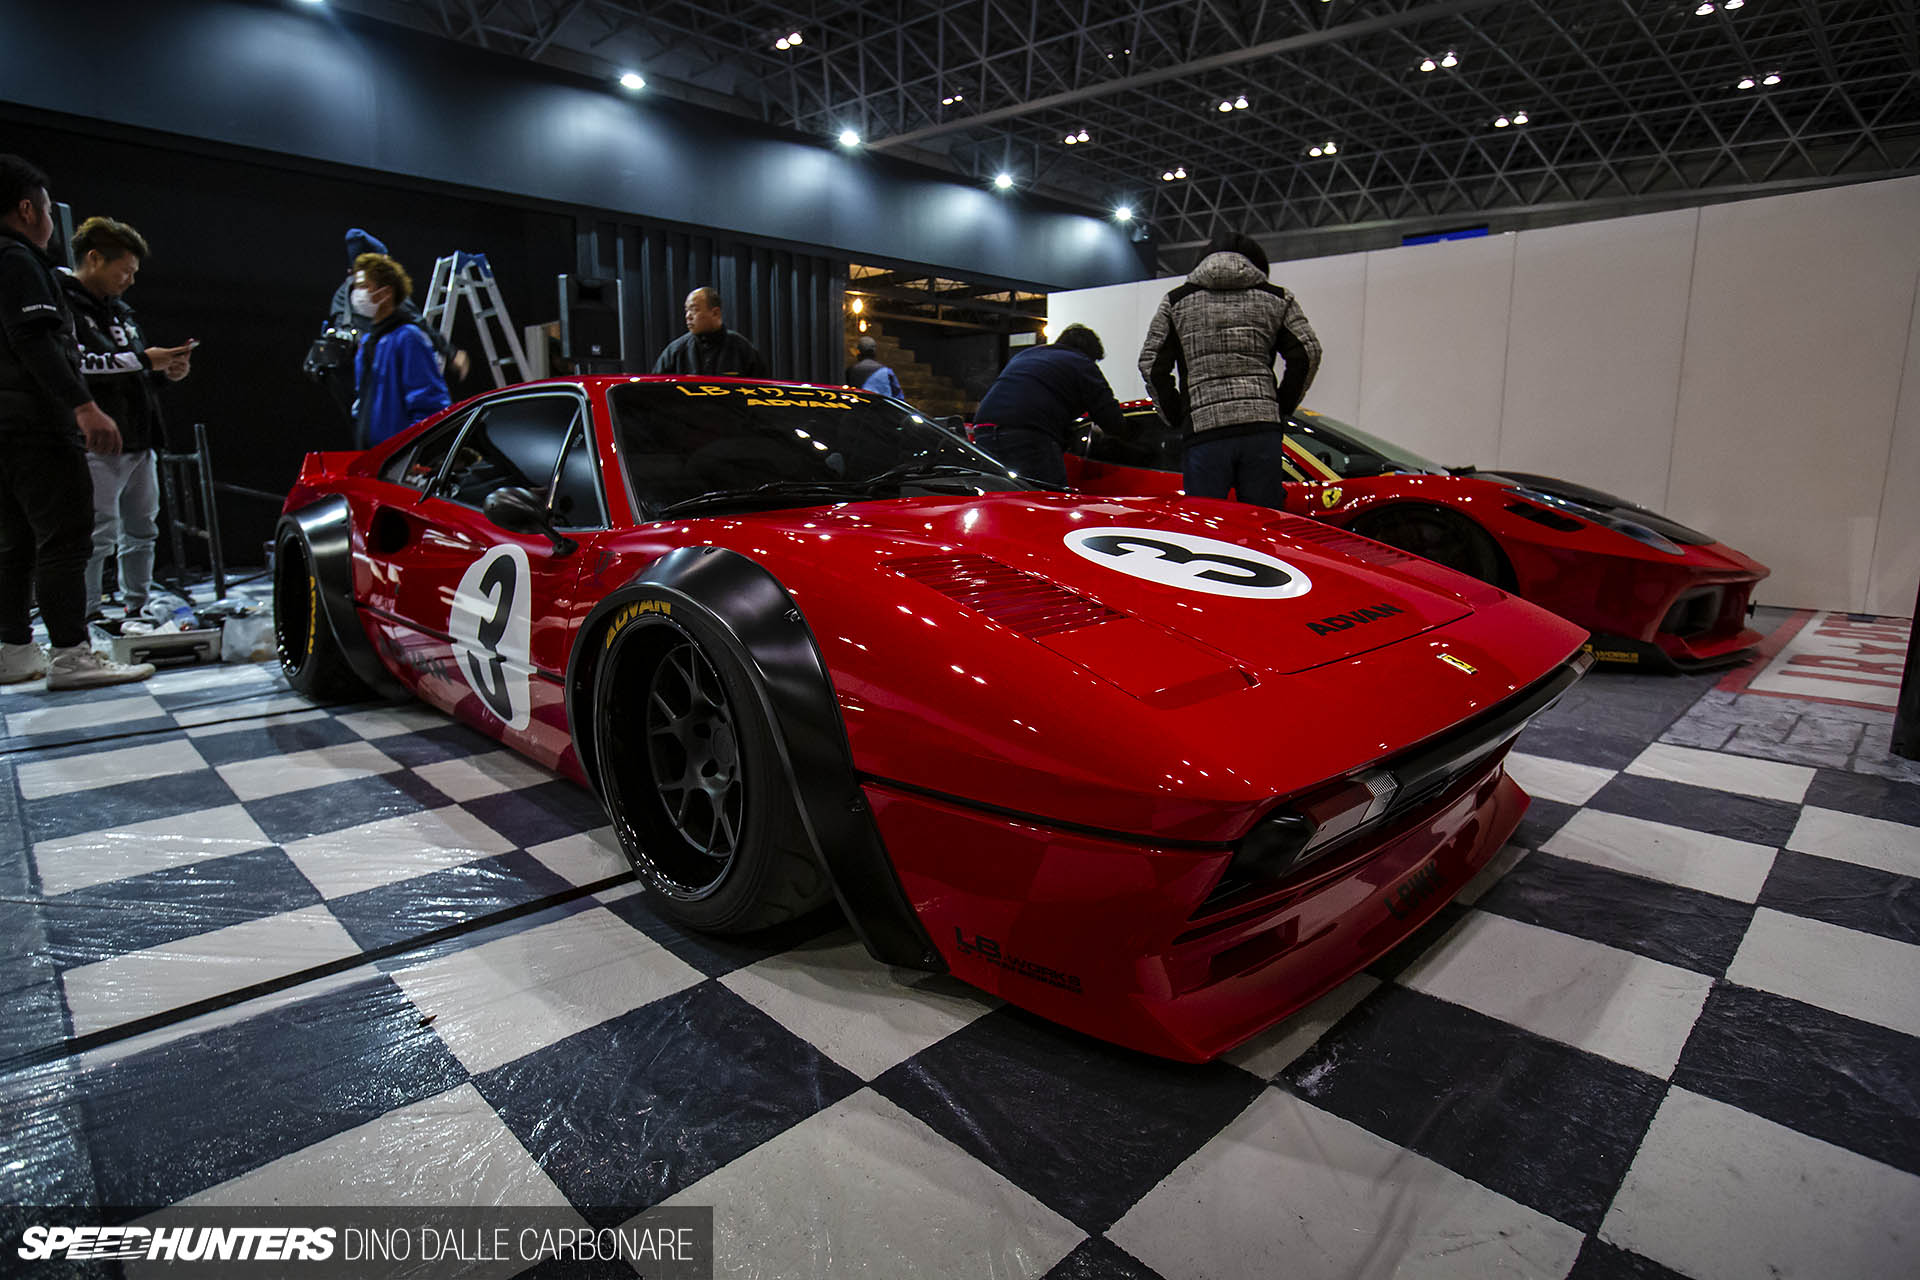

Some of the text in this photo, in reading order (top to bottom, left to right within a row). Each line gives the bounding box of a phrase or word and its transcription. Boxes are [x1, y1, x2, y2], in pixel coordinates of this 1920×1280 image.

[747, 398, 852, 410] ADVAN
[1081, 535, 1292, 588] 3
[466, 554, 518, 722] 3
[606, 600, 671, 649] ADVAN
[1305, 602, 1406, 637] ADVAN
[954, 926, 1001, 960] LB
